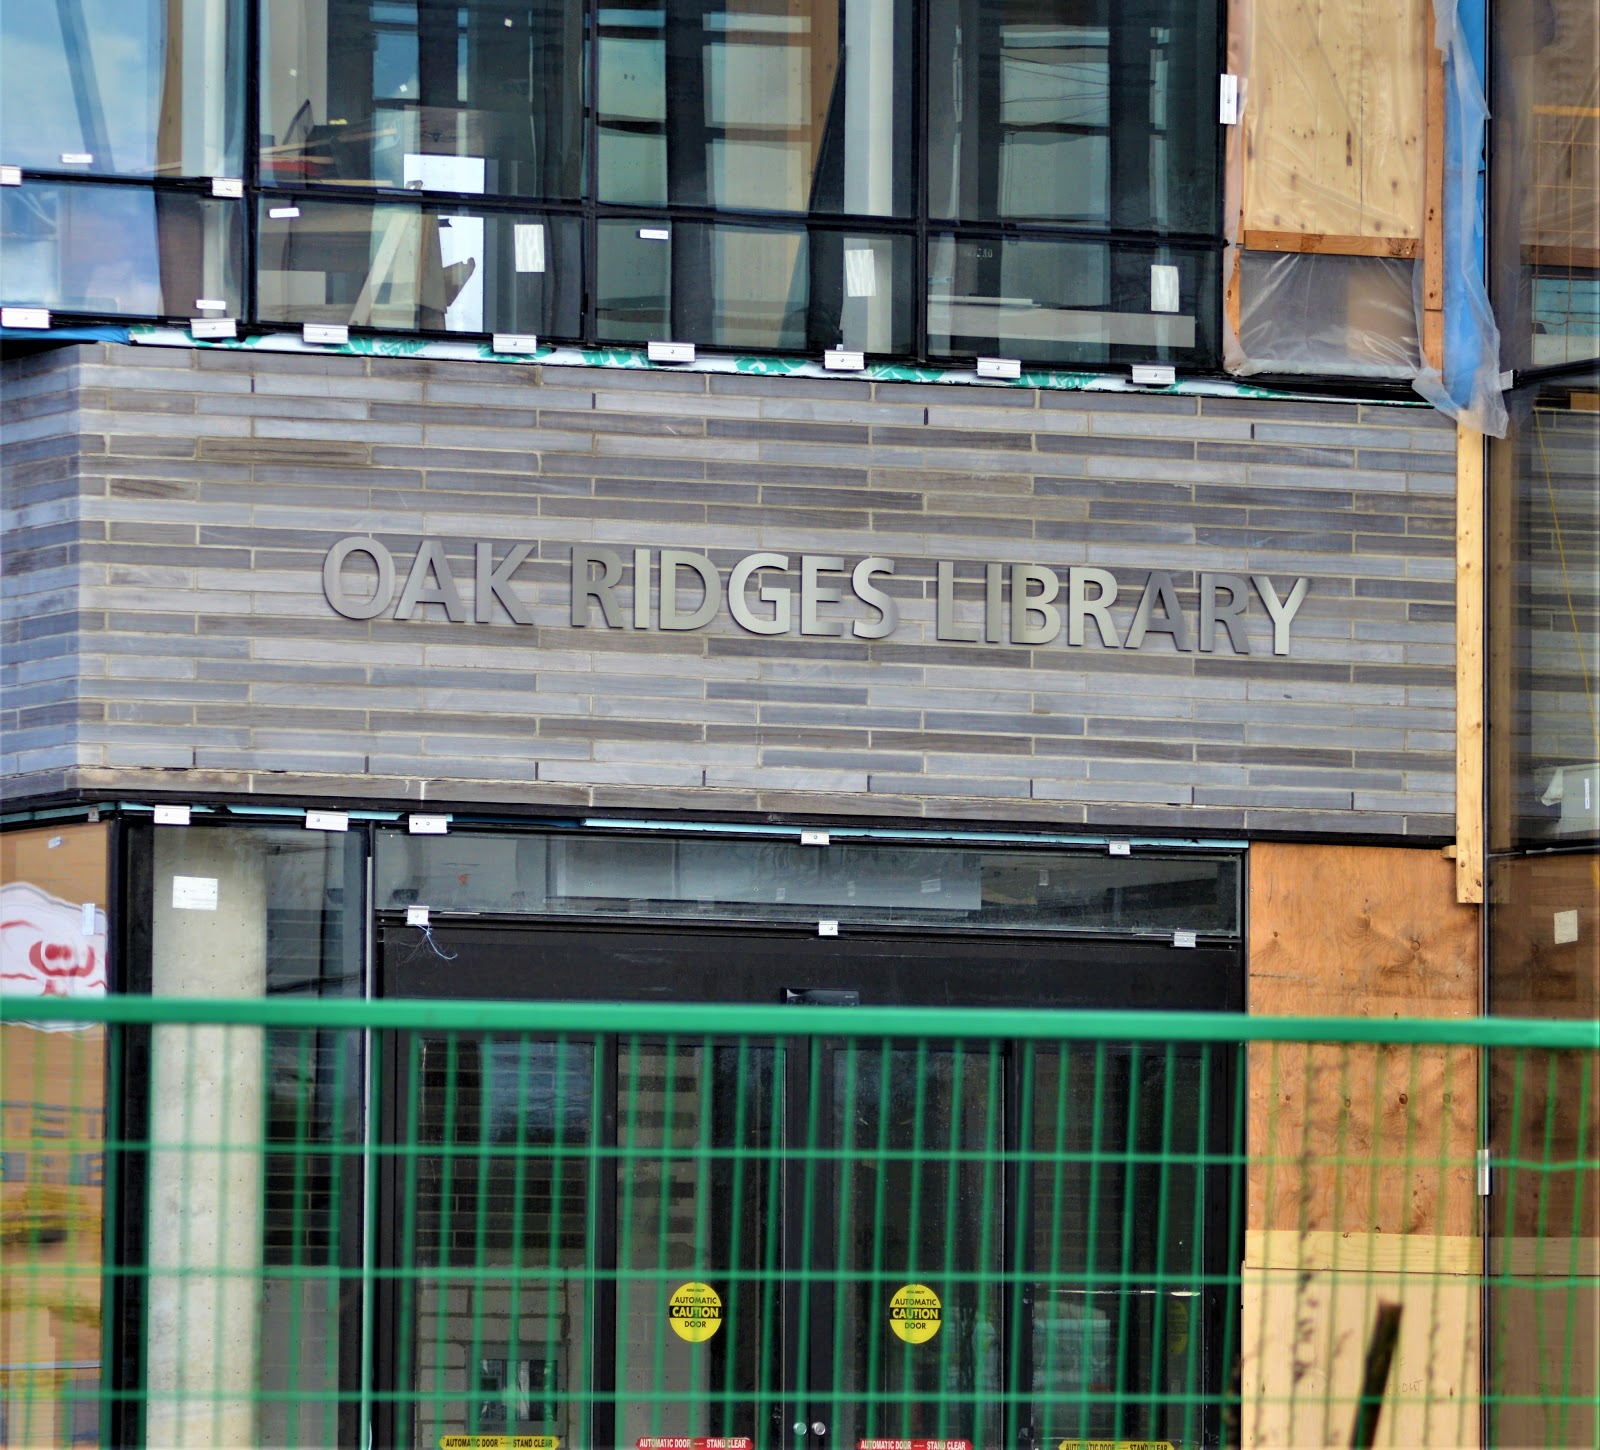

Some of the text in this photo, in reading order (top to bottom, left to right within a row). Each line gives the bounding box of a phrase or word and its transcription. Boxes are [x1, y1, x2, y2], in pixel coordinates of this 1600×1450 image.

[322, 536, 1311, 656] OAK RIDGES LIBRARY
[674, 1296, 717, 1304] AUTOMATIC
[894, 1298, 937, 1306] AUTOMATIC
[672, 1306, 719, 1318] CAUTION
[892, 1308, 939, 1319] CAUTION
[684, 1320, 707, 1328] DOOR
[445, 1438, 553, 1448] AUTOMATIC DOOR STAND CLEAR
[639, 1438, 746, 1449] AUTOMATIC DOOR STAND CLEAR
[860, 1440, 895, 1450] AUTOMATIC
[895, 1440, 912, 1450] DOOR
[926, 1441, 946, 1450] STAND
[946, 1441, 966, 1450] CLEAR
